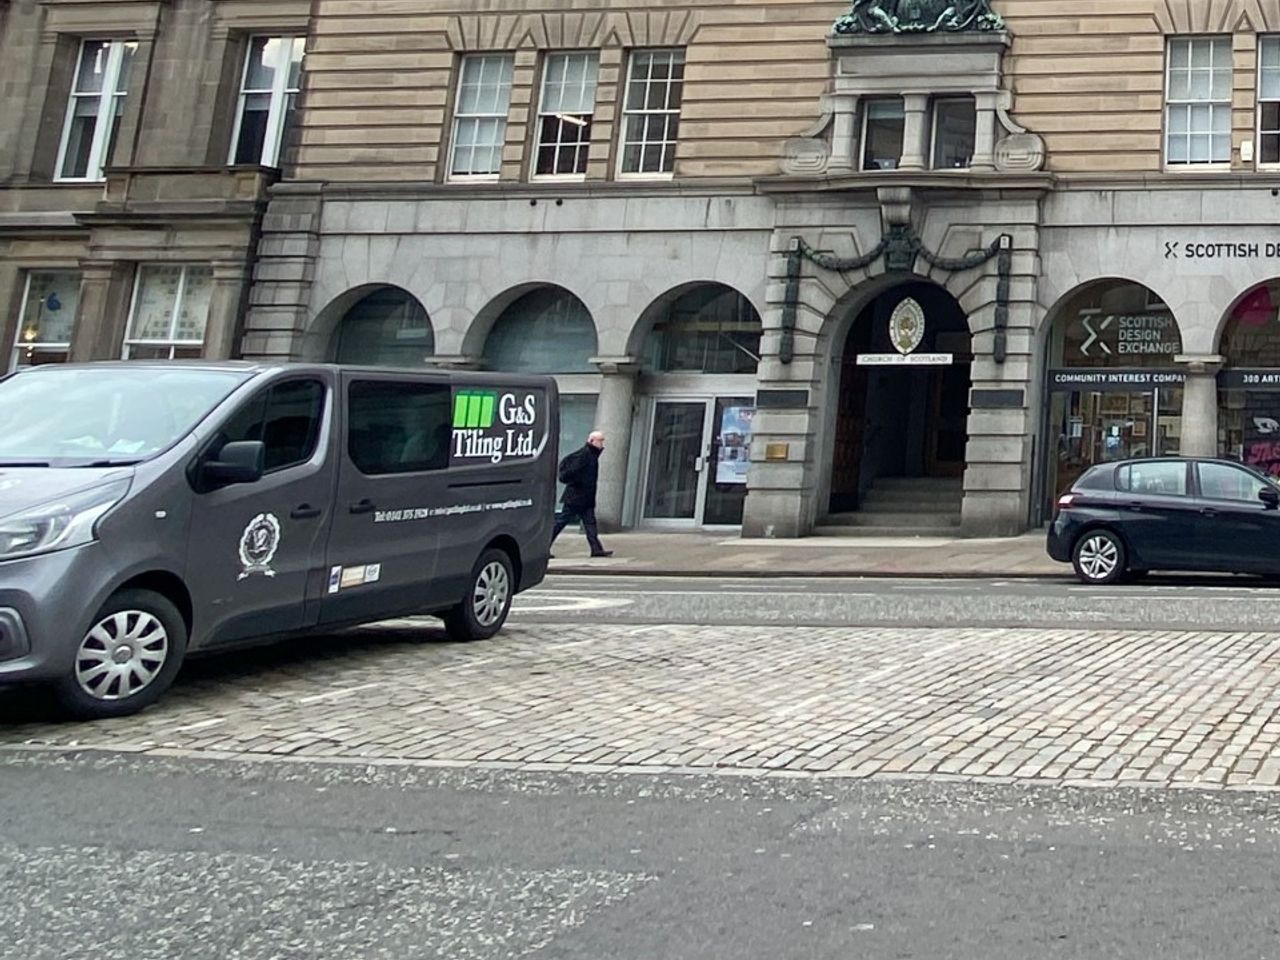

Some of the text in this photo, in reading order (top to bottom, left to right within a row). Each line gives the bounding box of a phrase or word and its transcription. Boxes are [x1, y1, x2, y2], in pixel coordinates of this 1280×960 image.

[1185, 243, 1259, 258] SCOTTISH
[1118, 316, 1173, 329] SCOTTISH
[1118, 329, 1161, 341] DESIGN
[1117, 342, 1180, 354] EXCHANGE
[1054, 373, 1106, 383] COMMUNITY
[1108, 373, 1151, 383] INTEREST
[499, 393, 535, 425] G&S
[452, 429, 538, 463] Tiling Ltd.
